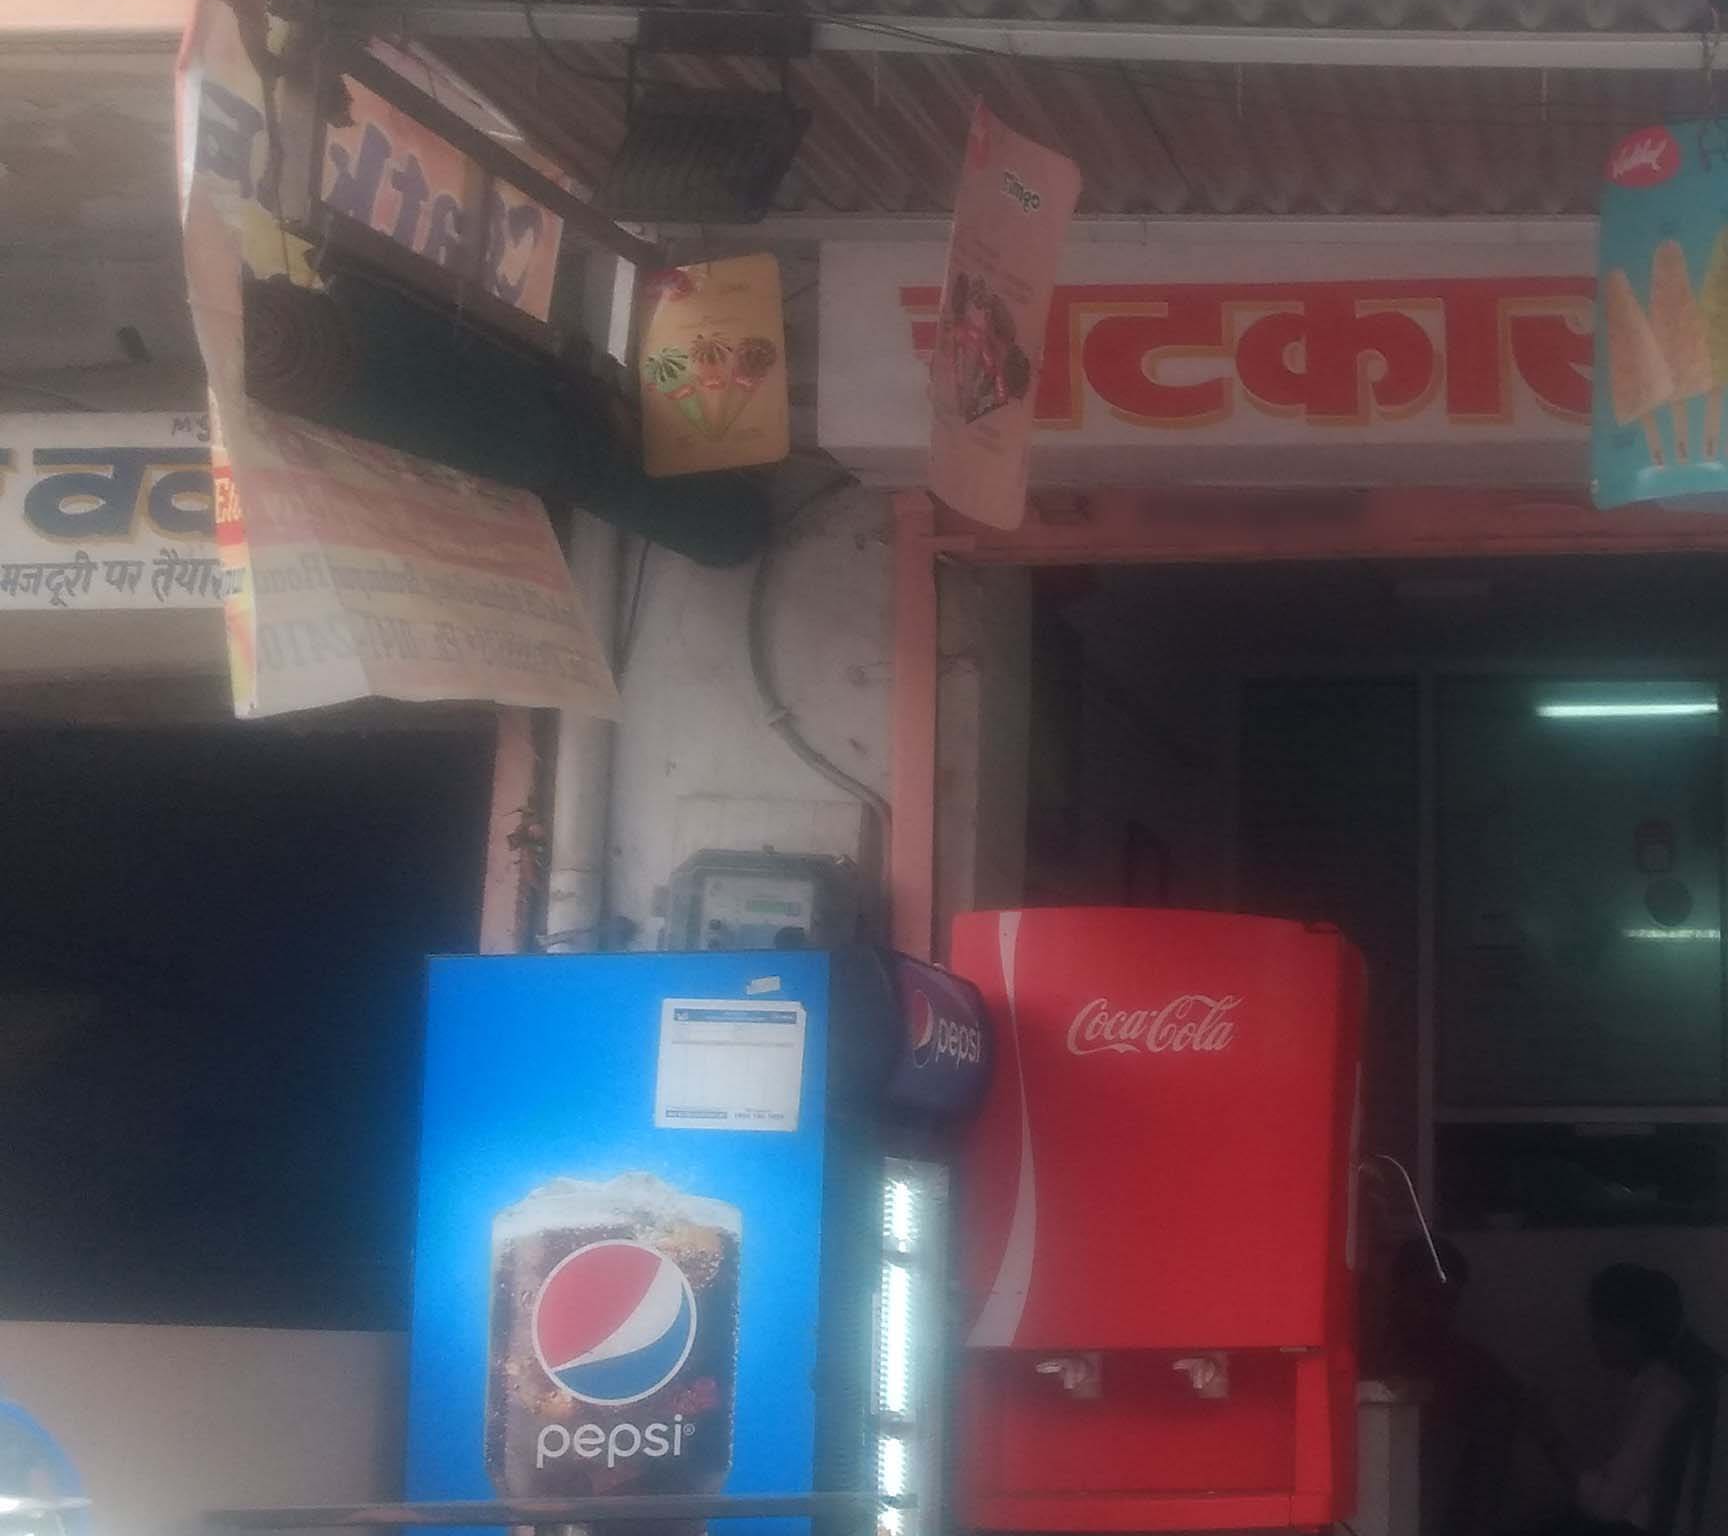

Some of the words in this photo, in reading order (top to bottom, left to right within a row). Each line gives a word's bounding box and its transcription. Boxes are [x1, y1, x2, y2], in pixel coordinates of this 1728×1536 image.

[103, 560, 146, 593] पर
[935, 1017, 982, 1071] pepsi
[1067, 994, 1244, 1055] Coca-Cola
[536, 1414, 683, 1469] pepsi
